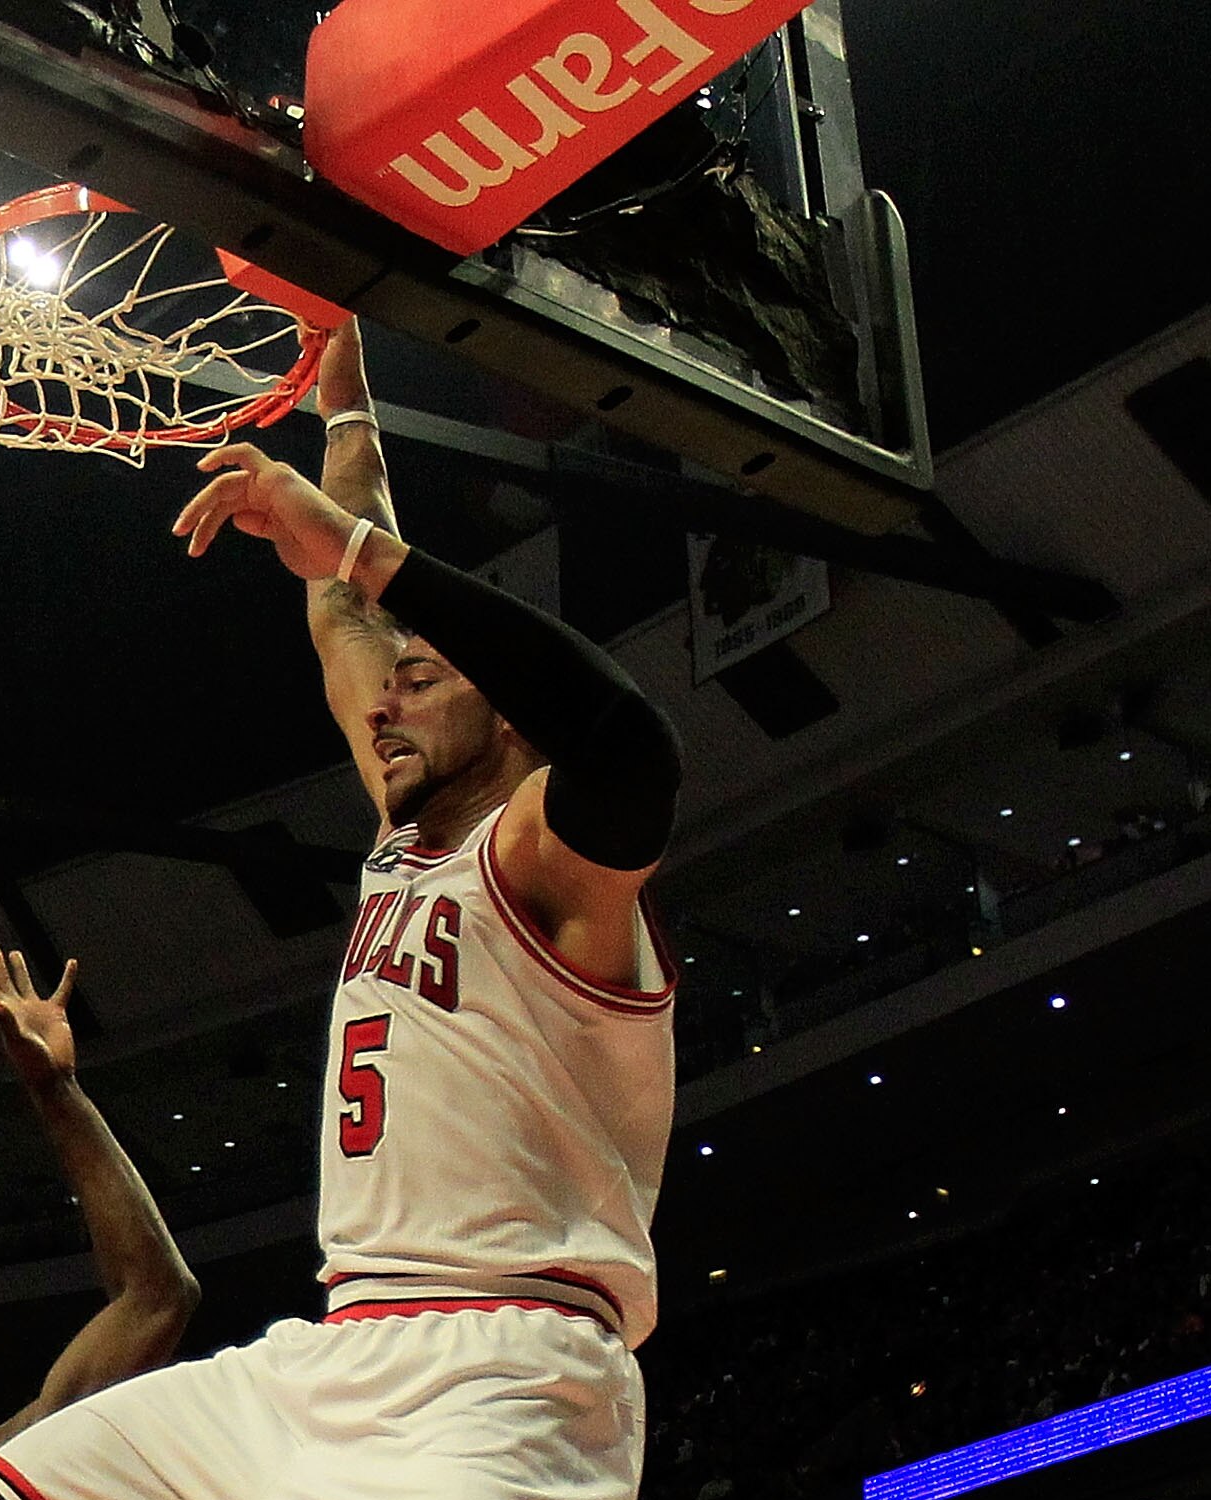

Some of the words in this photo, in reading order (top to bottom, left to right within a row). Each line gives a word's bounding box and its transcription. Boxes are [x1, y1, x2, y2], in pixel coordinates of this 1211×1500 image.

[389, 0, 714, 207] Farm
[344, 889, 461, 1012] ULLS
[339, 1014, 391, 1158] 5
